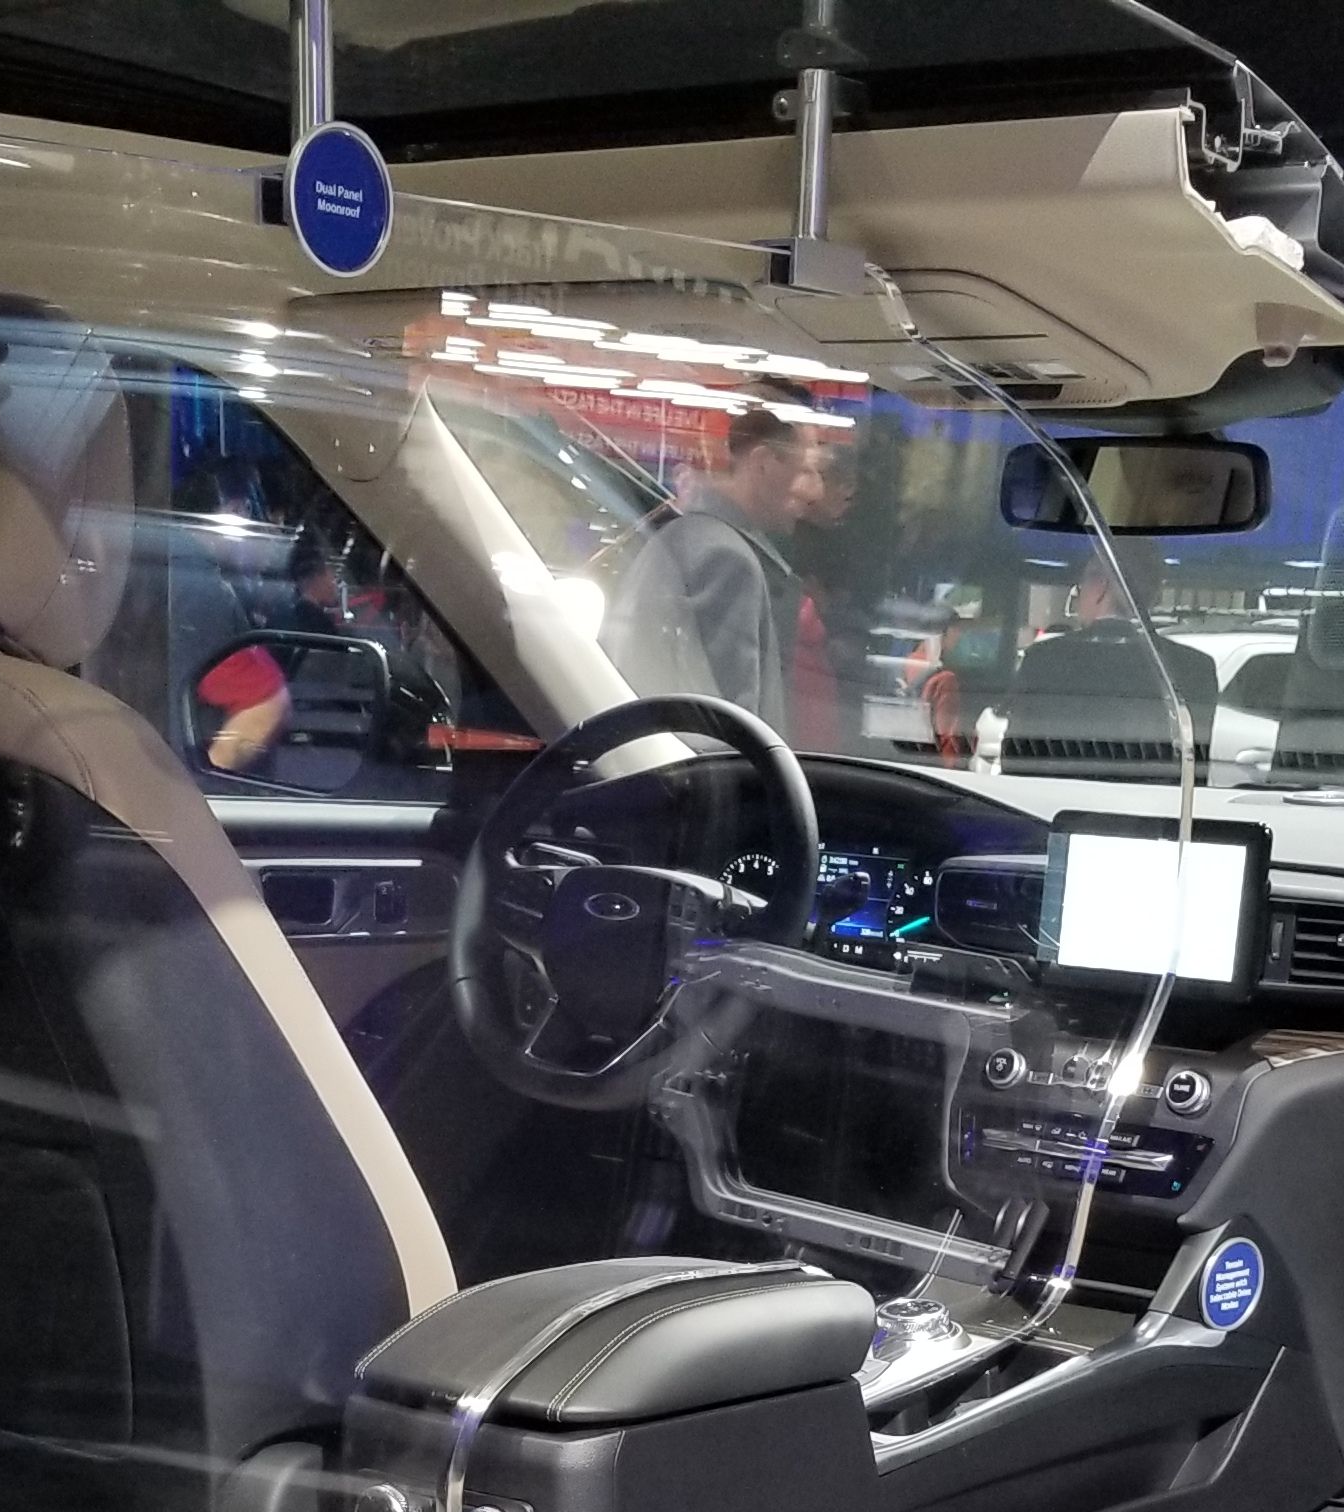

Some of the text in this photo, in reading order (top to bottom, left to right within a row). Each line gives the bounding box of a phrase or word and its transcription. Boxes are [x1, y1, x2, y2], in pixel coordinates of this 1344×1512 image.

[315, 180, 363, 203] Dual Panel
[317, 198, 361, 219] Moonroof
